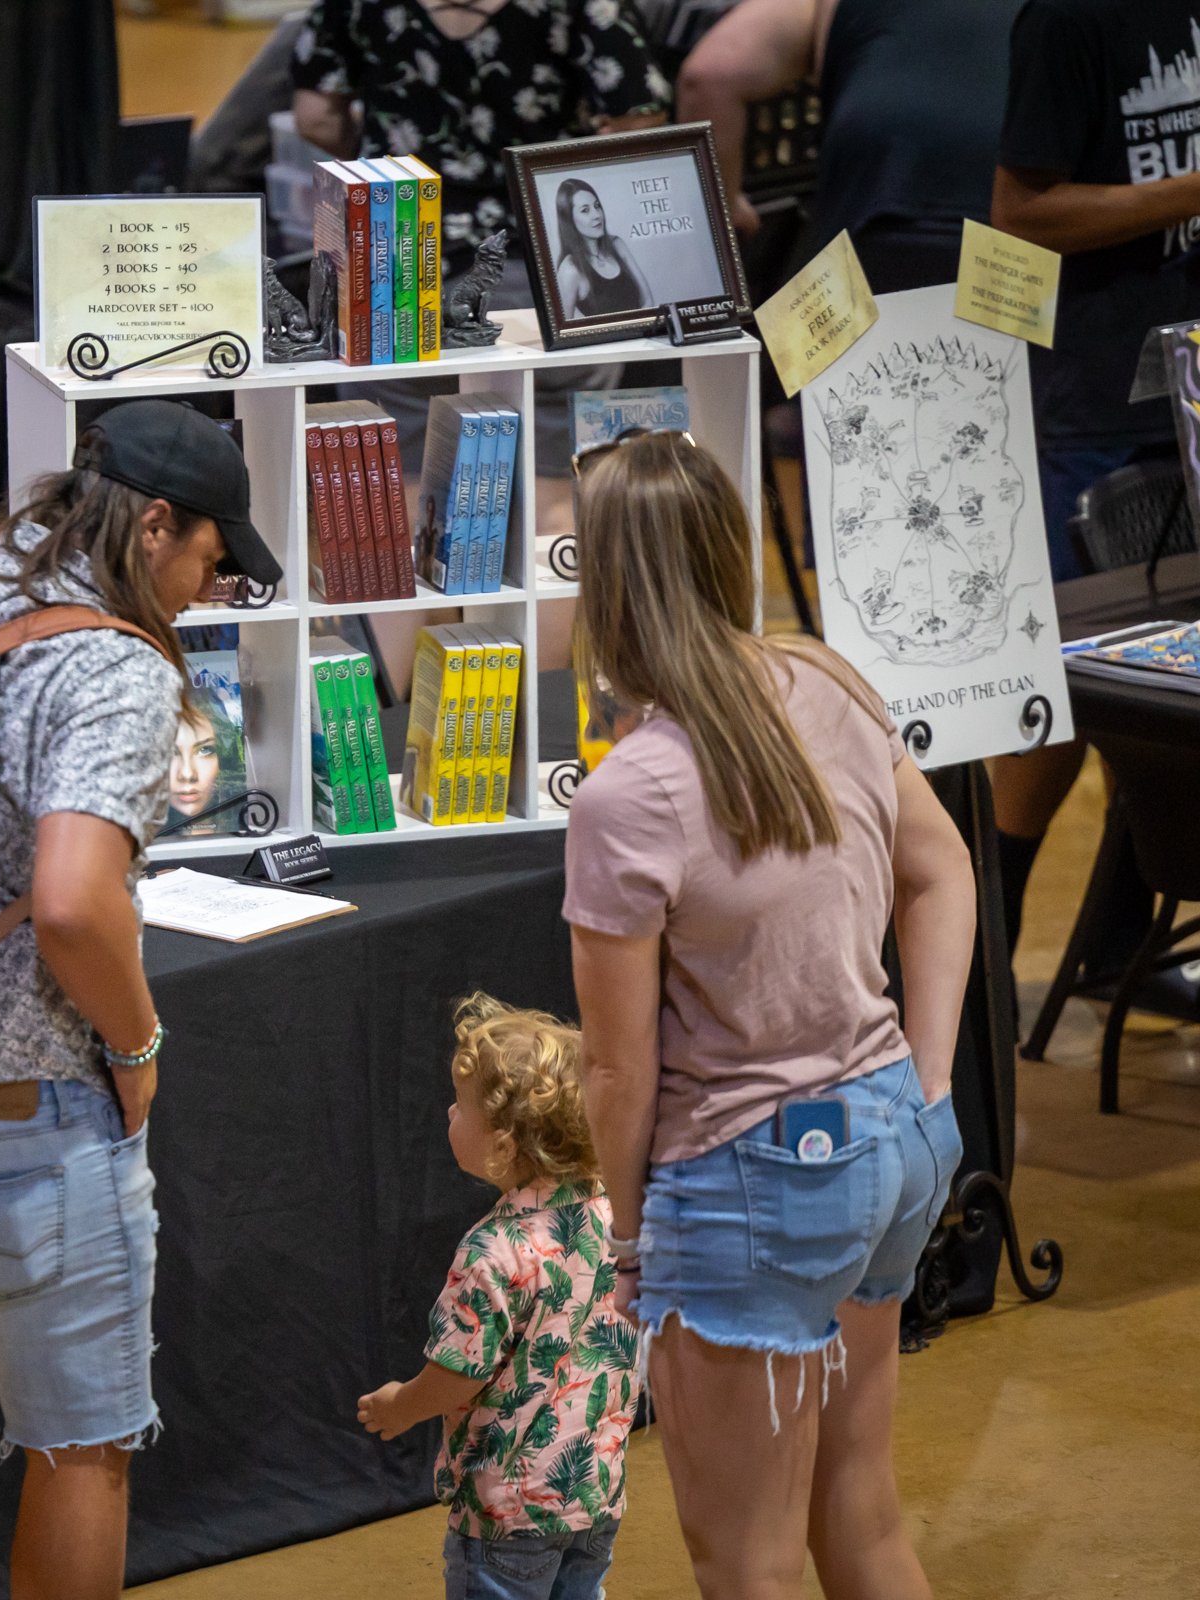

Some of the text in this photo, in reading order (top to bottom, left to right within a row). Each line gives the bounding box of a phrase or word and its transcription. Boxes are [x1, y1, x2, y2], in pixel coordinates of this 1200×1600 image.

[1125, 119, 1156, 140] IT'S
[631, 176, 670, 195] MEET
[640, 198, 671, 215] THE
[109, 224, 113, 233] 1
[120, 223, 155, 233] BOOK
[175, 223, 190, 232] $15
[629, 216, 693, 238] AUTHOR
[102, 244, 110, 253] 2
[117, 243, 159, 253] BOOKS
[179, 243, 198, 253] $25
[354, 230, 365, 300] PREPARATIONS
[377, 238, 389, 285] TRIALS
[401, 221, 413, 290] The RETURN
[425, 222, 437, 290] The BROKEN
[103, 264, 110, 276] 3
[116, 263, 158, 273] BOOKS
[178, 263, 197, 274] $40
[104, 285, 111, 296] 4
[114, 284, 156, 293] BOOKS
[176, 283, 196, 293] $50
[974, 255, 1044, 287] THE HUNGER GAMES
[88, 303, 156, 313] HARDCOVER
[159, 303, 178, 312] SET
[190, 303, 214, 312] $100
[678, 300, 734, 316] THE LEGACY
[808, 304, 835, 337] FREE
[972, 285, 986, 298] THE
[987, 290, 1039, 316] PREPARATIONS
[805, 336, 829, 361] BOOK
[604, 402, 685, 425] TRIALS
[314, 473, 331, 539] PREPARATIONS
[332, 472, 349, 539] PREPARATIONS
[351, 471, 368, 538] PREPARATIONS
[370, 470, 386, 537] PREPARATIONS
[389, 467, 404, 534] PREPARATIONS
[458, 479, 471, 519] TRIALS
[478, 478, 490, 518] TRIALS
[494, 476, 508, 517] TRIALS
[886, 674, 1036, 717] HE LAND OF THE CLAN
[328, 721, 343, 769] RETURN
[346, 719, 362, 767] RETURN
[366, 716, 382, 764] RETURN
[445, 712, 457, 761] BROKEN
[462, 711, 477, 759] BROKEN
[480, 710, 495, 758] BROKEN
[500, 709, 513, 758] BROKEN
[273, 842, 321, 861] THE LEGACY
